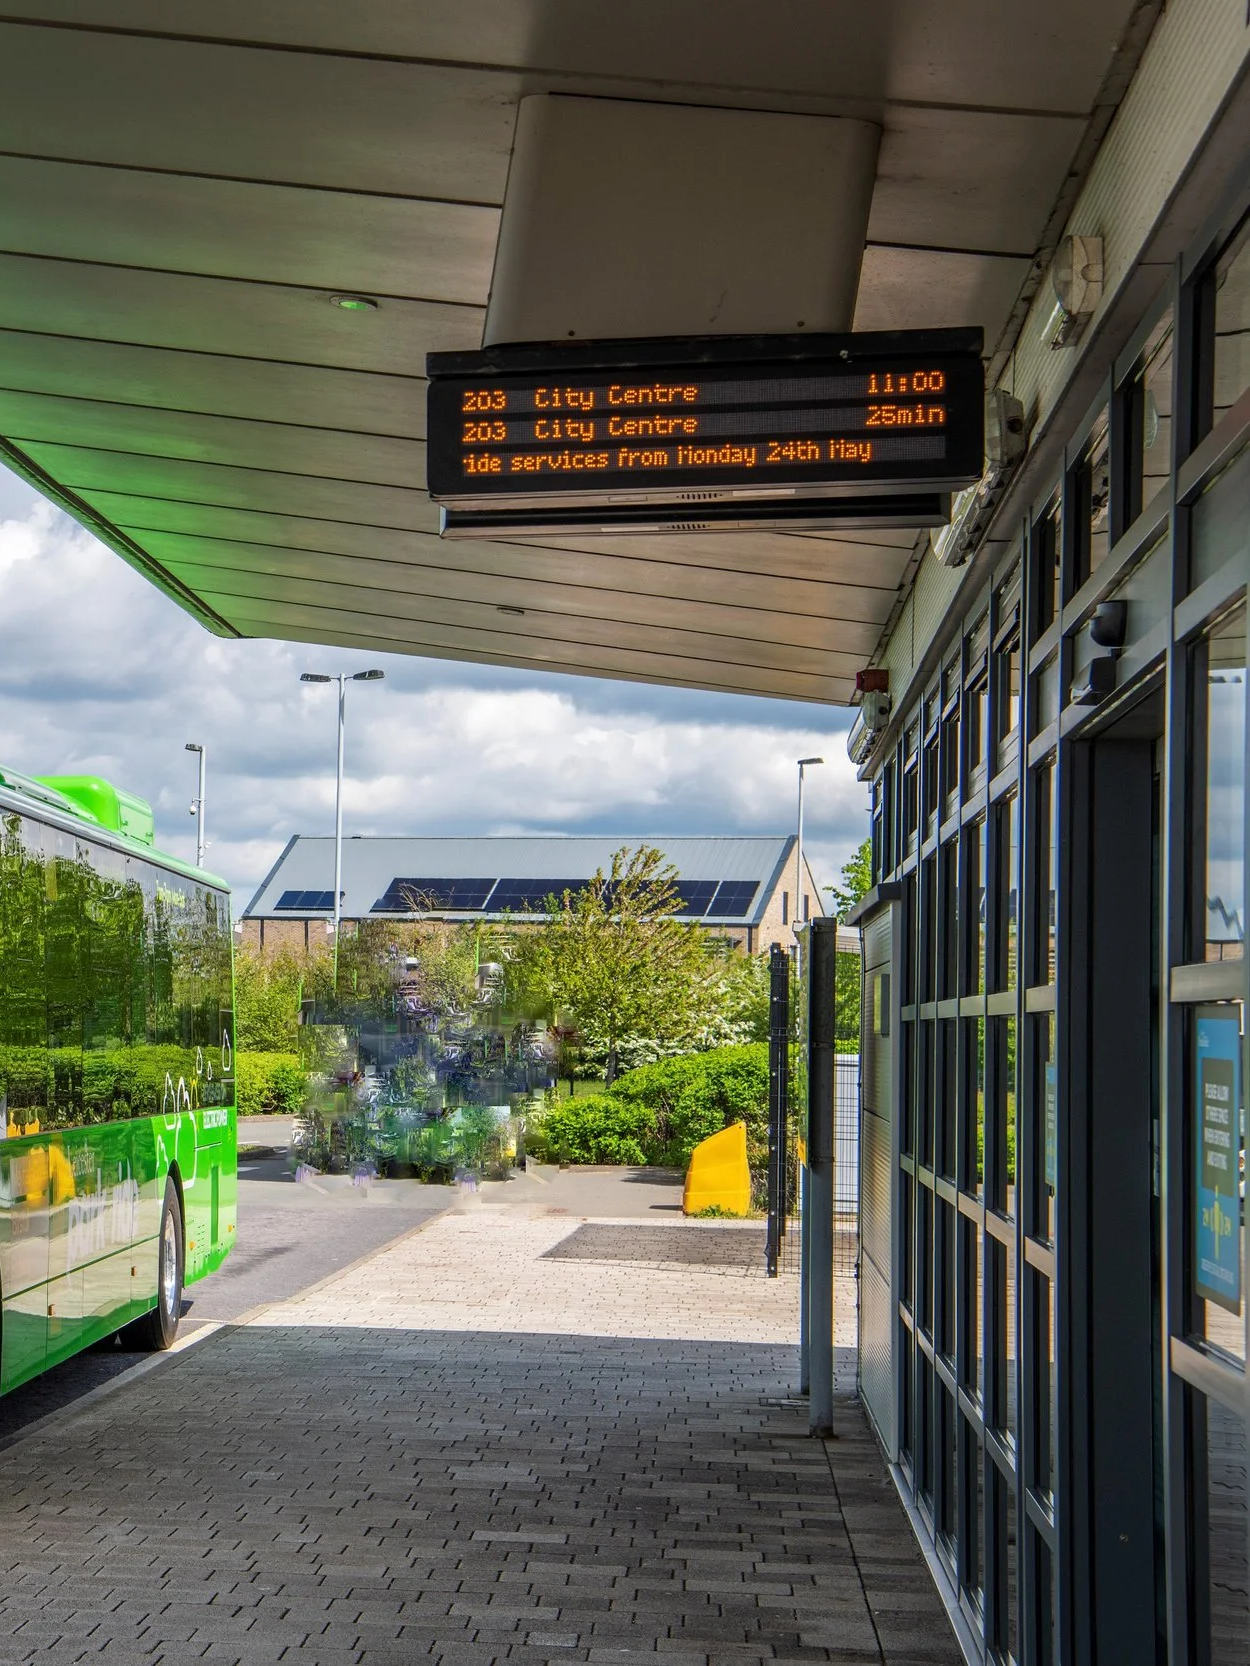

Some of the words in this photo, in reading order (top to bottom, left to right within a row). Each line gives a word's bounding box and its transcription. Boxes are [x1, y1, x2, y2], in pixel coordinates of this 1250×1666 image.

[462, 391, 506, 411] 203
[535, 388, 594, 410] City
[608, 383, 698, 404] Centre
[867, 371, 944, 393] 11:00
[462, 421, 506, 442] 203
[535, 418, 594, 442] City
[608, 415, 698, 436] Centre
[866, 404, 944, 425] 25min
[463, 453, 502, 473] ide
[511, 450, 609, 472] services
[618, 447, 668, 468] from
[678, 444, 756, 468] Monday
[766, 440, 819, 462] 24th
[830, 438, 871, 462] May
